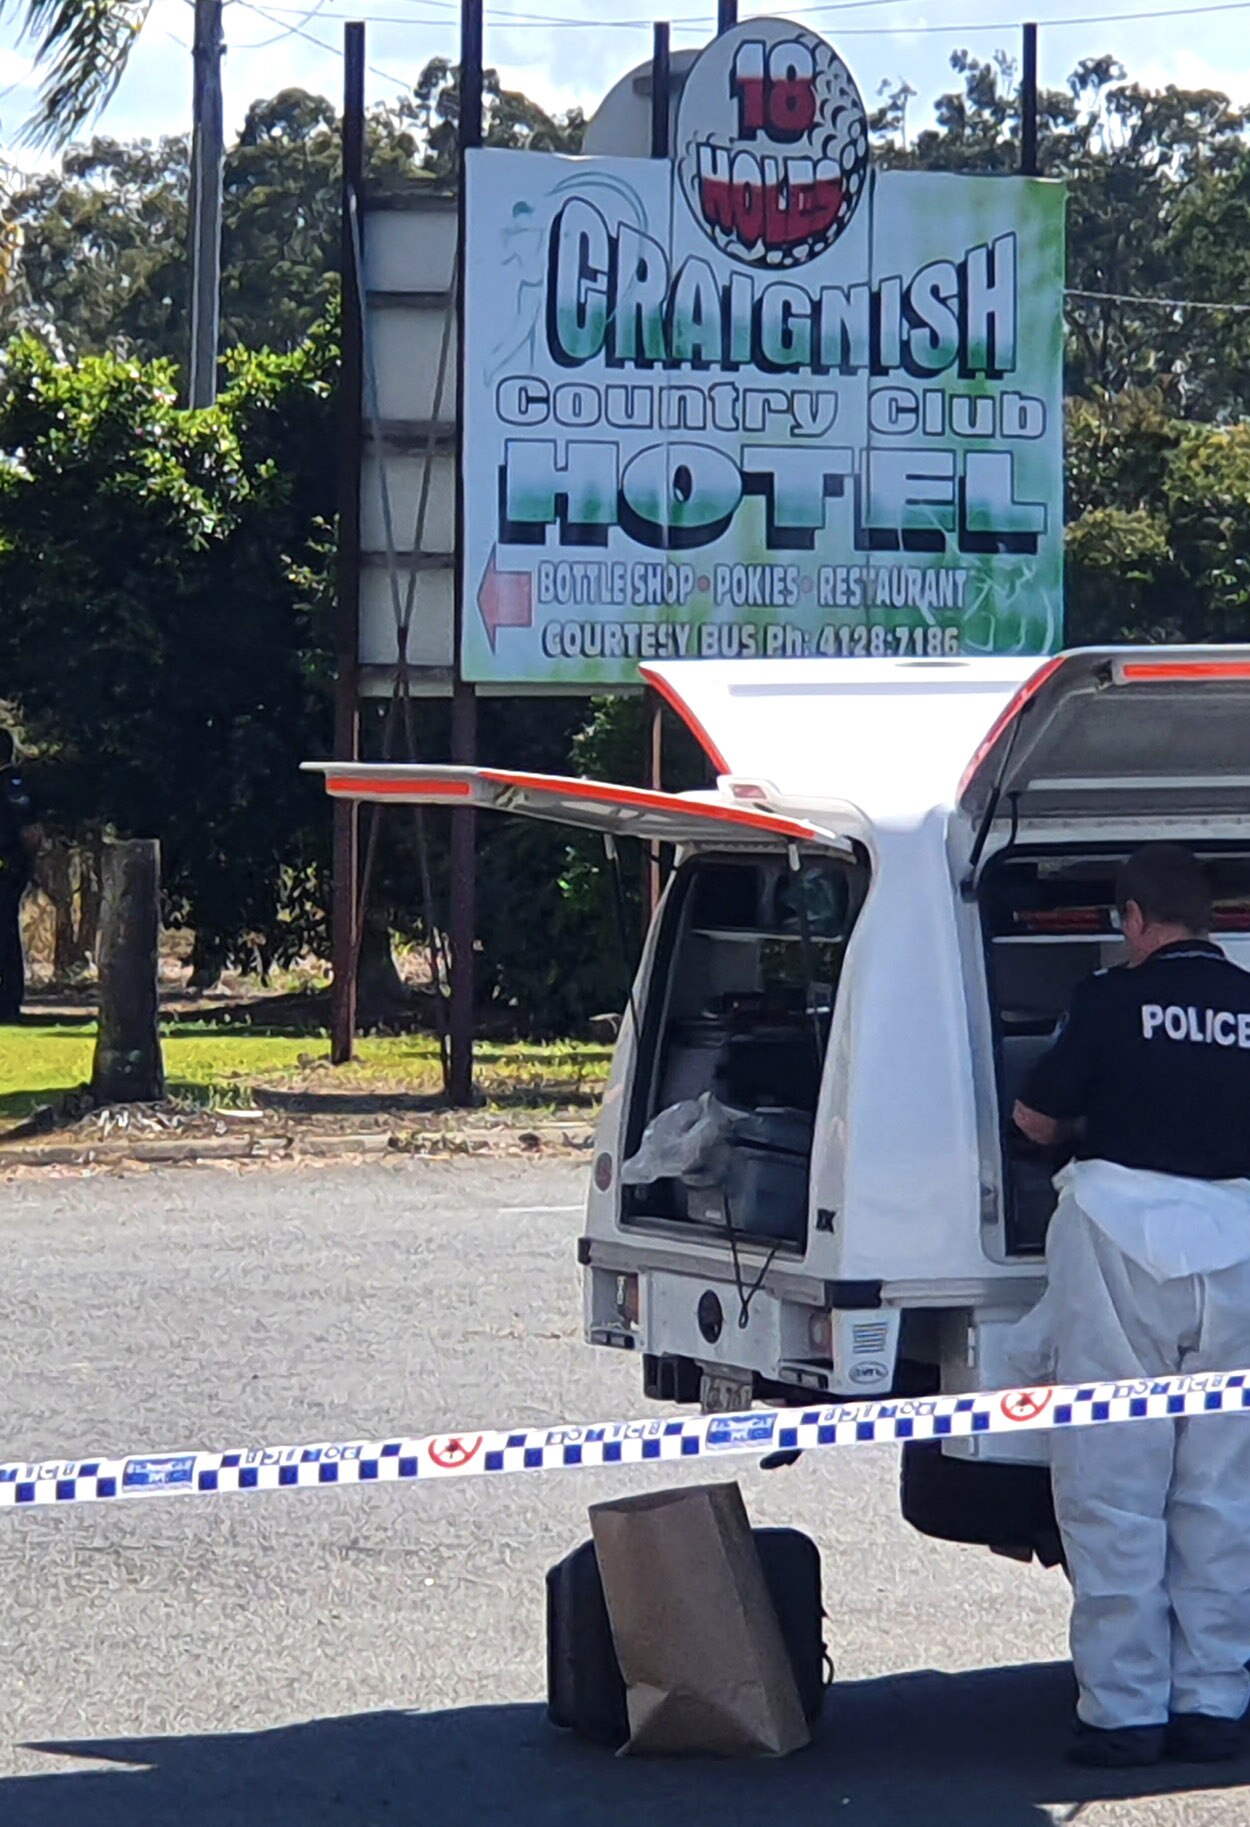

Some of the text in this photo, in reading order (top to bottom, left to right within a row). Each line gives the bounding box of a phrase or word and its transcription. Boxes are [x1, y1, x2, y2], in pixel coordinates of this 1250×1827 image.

[730, 39, 817, 143] 18
[696, 142, 845, 250] HOLES
[545, 196, 1018, 380] CRAIGNISH
[496, 375, 1047, 439] Country Club
[498, 438, 1047, 554] HOTEL
[538, 560, 968, 609] BOTTLE SHOP POKIES RESTAURANT
[542, 620, 691, 658] COURTESY
[696, 622, 759, 658] BUS
